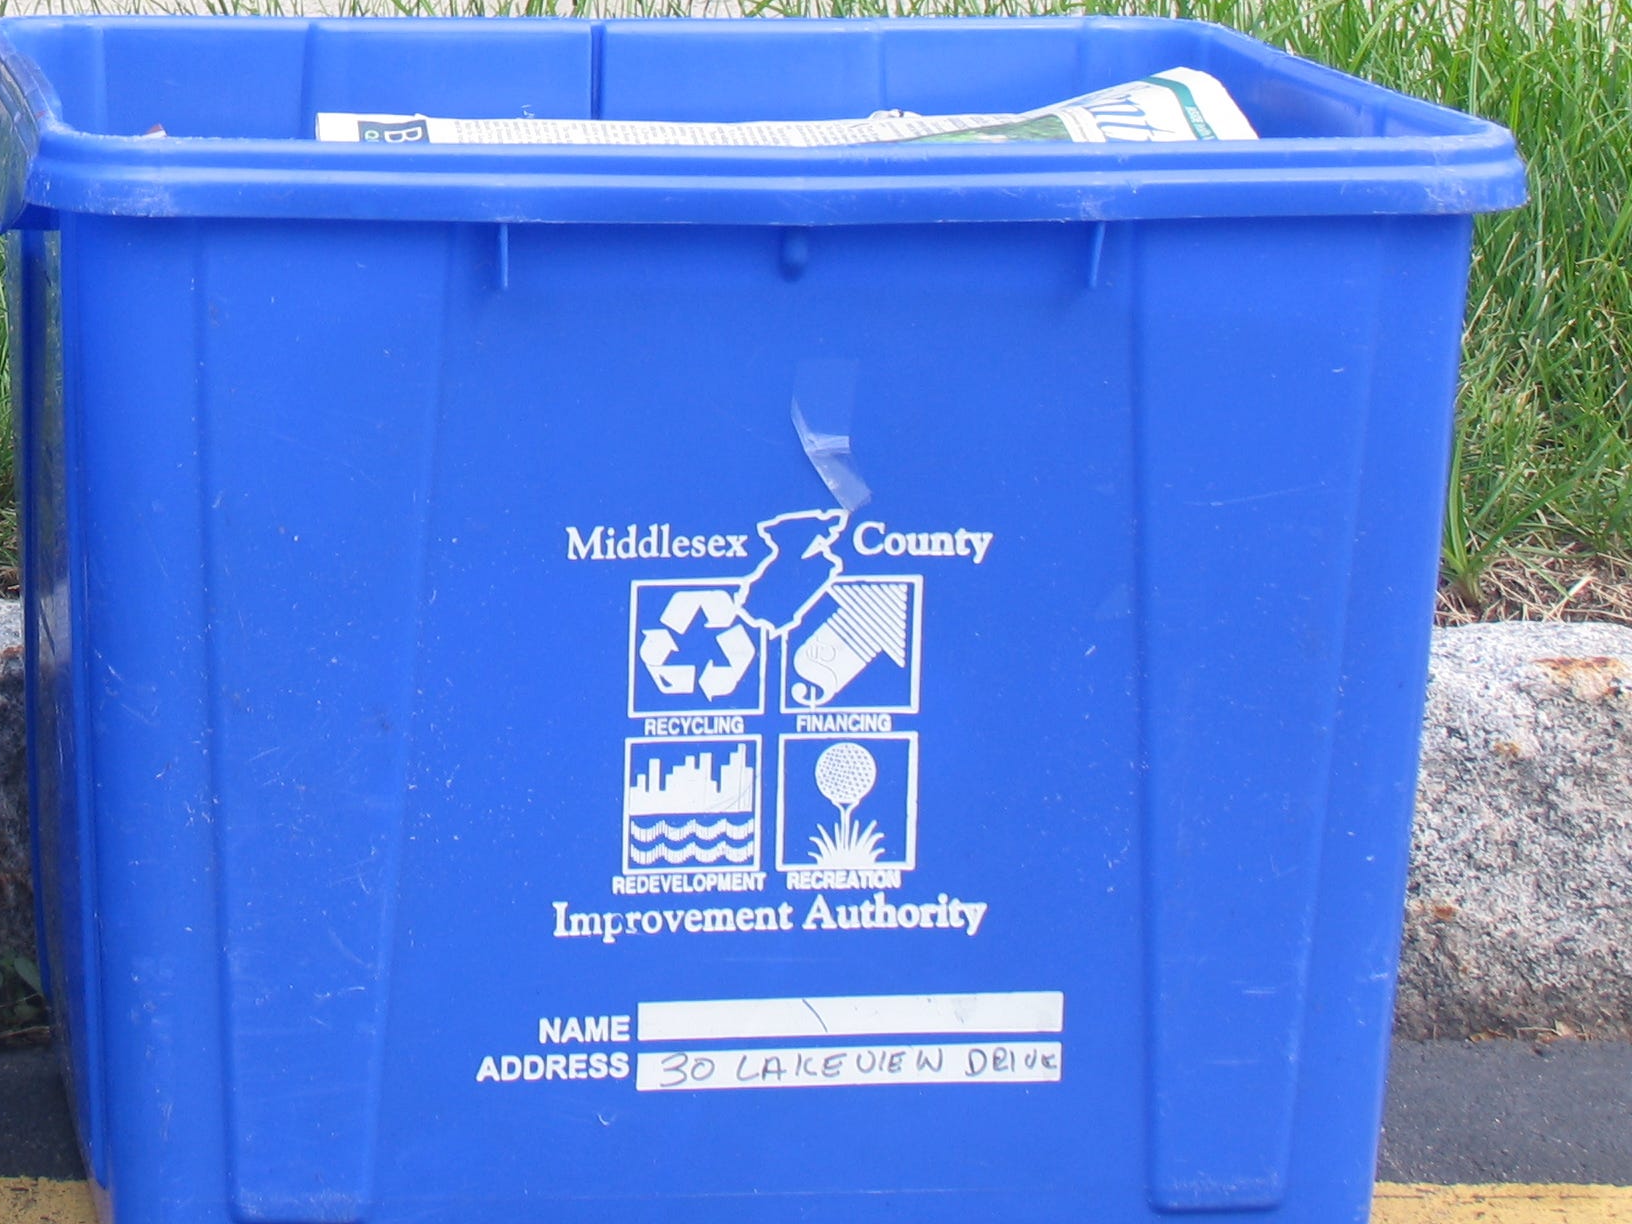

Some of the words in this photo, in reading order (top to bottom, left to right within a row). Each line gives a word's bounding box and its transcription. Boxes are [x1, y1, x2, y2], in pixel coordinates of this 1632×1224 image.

[566, 523, 748, 560] Middlesex
[853, 521, 993, 564] County
[644, 715, 744, 736] RECYCLING
[796, 713, 892, 733] FINANCING
[612, 872, 766, 895] REDEVELOPMENT
[786, 869, 900, 890] RECREATION
[553, 902, 793, 944] Improvement
[802, 892, 988, 936] Authority
[539, 1015, 631, 1044] NAME
[476, 1051, 630, 1082] ADDRESS
[660, 1052, 715, 1087] 30
[736, 1047, 943, 1083] LAKEVIEW
